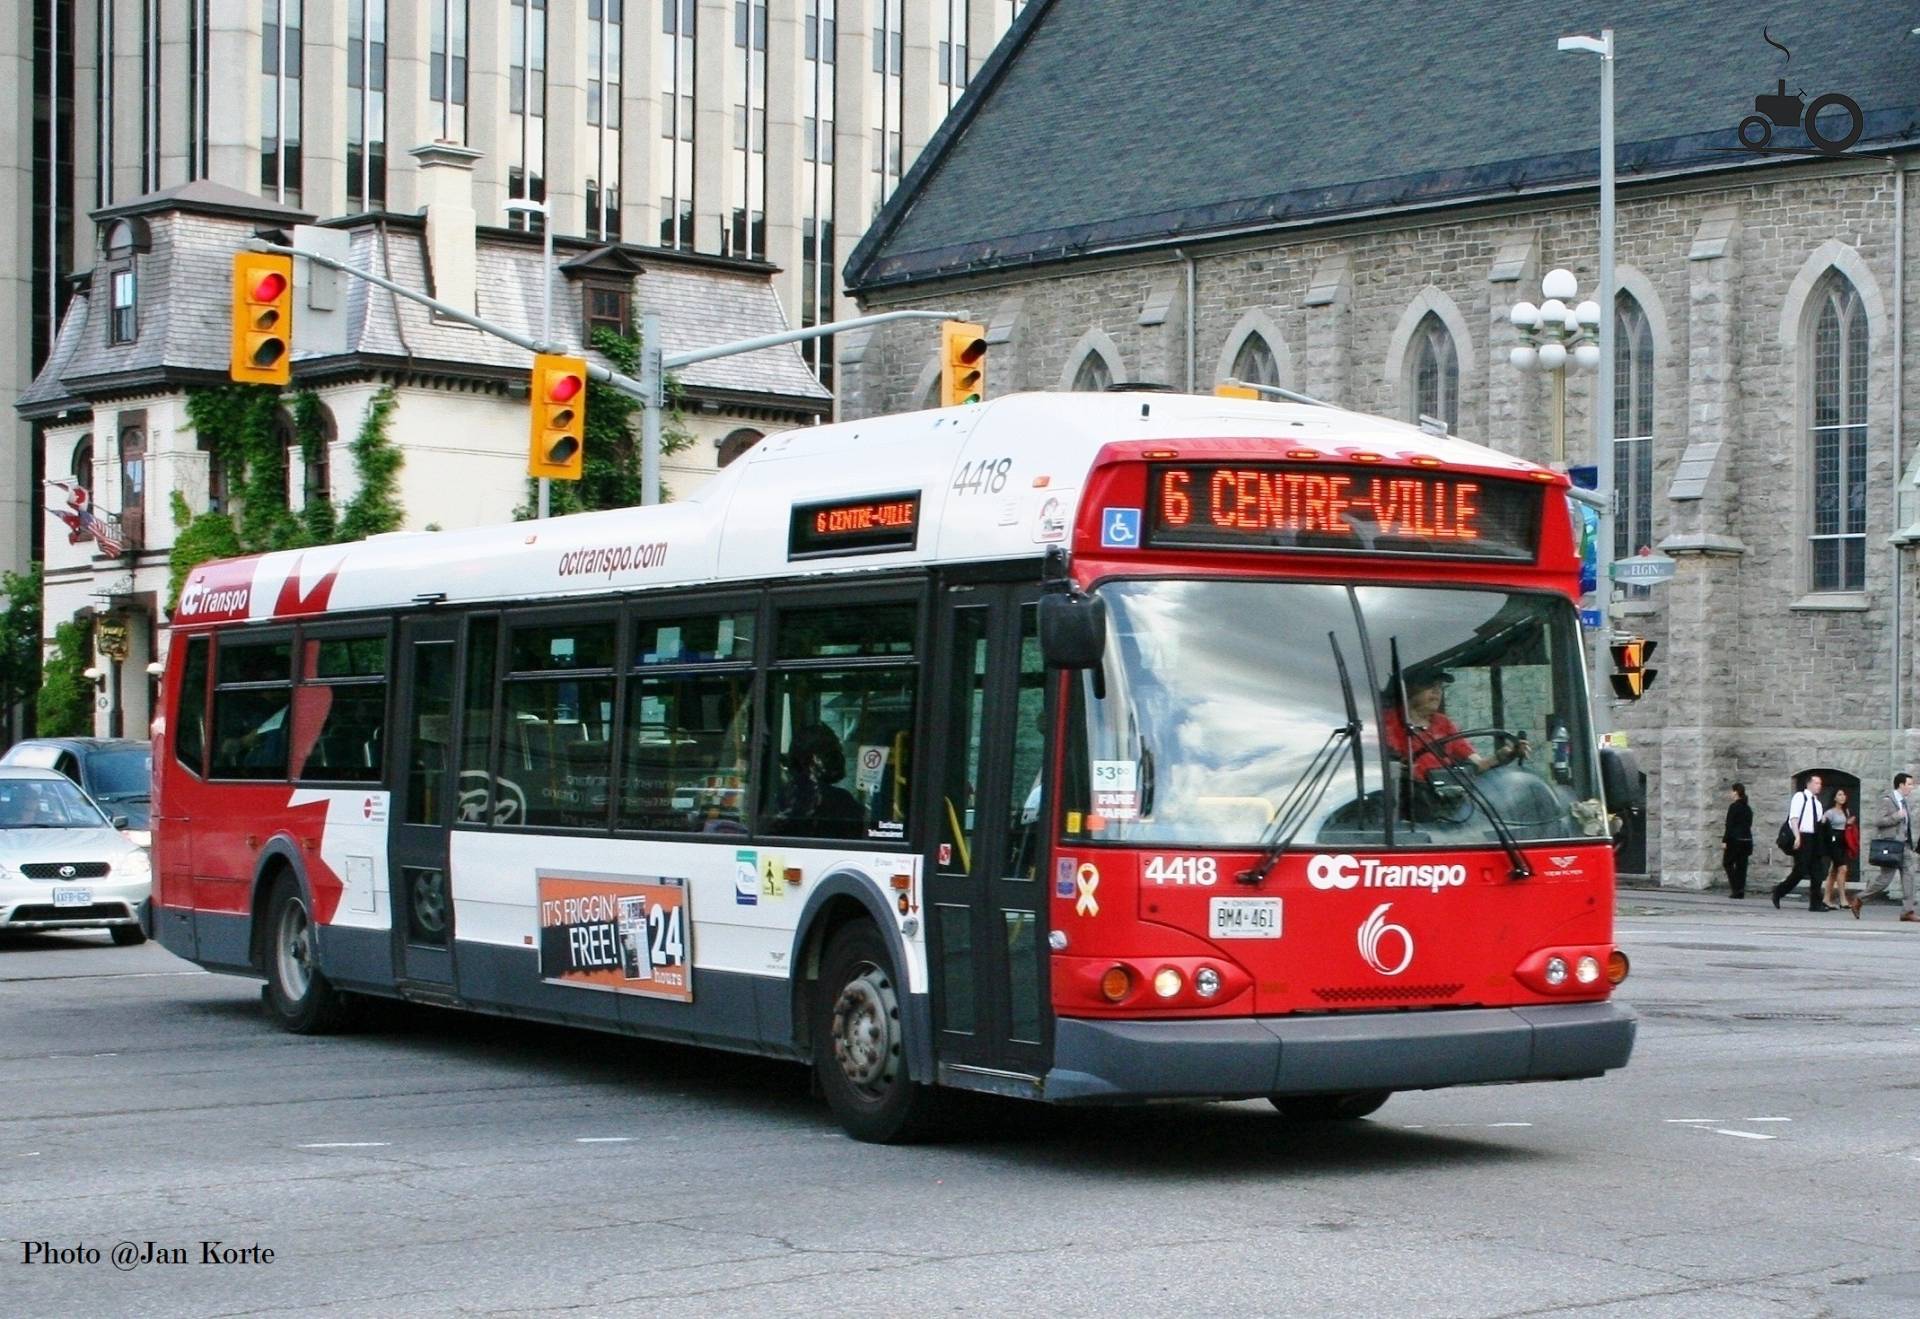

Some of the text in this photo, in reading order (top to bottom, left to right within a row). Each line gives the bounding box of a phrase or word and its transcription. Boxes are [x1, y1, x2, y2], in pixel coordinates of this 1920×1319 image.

[952, 457, 1012, 496] 4418
[816, 503, 913, 532] 6 CENTRE-VILLE
[1163, 470, 1478, 539] 6 CENTRE-VILLE
[558, 540, 668, 580] octranspo.com
[1631, 564, 1660, 576] ELGIN
[199, 587, 248, 617] Transpo
[1098, 793, 1135, 805] FARE
[1145, 857, 1217, 885] 4418
[1307, 854, 1467, 894] OC Transpo
[542, 893, 616, 928] IT'S FRIGGIN'
[569, 923, 618, 967] FREE!
[650, 903, 683, 966] 24
[653, 967, 682, 986] hours
